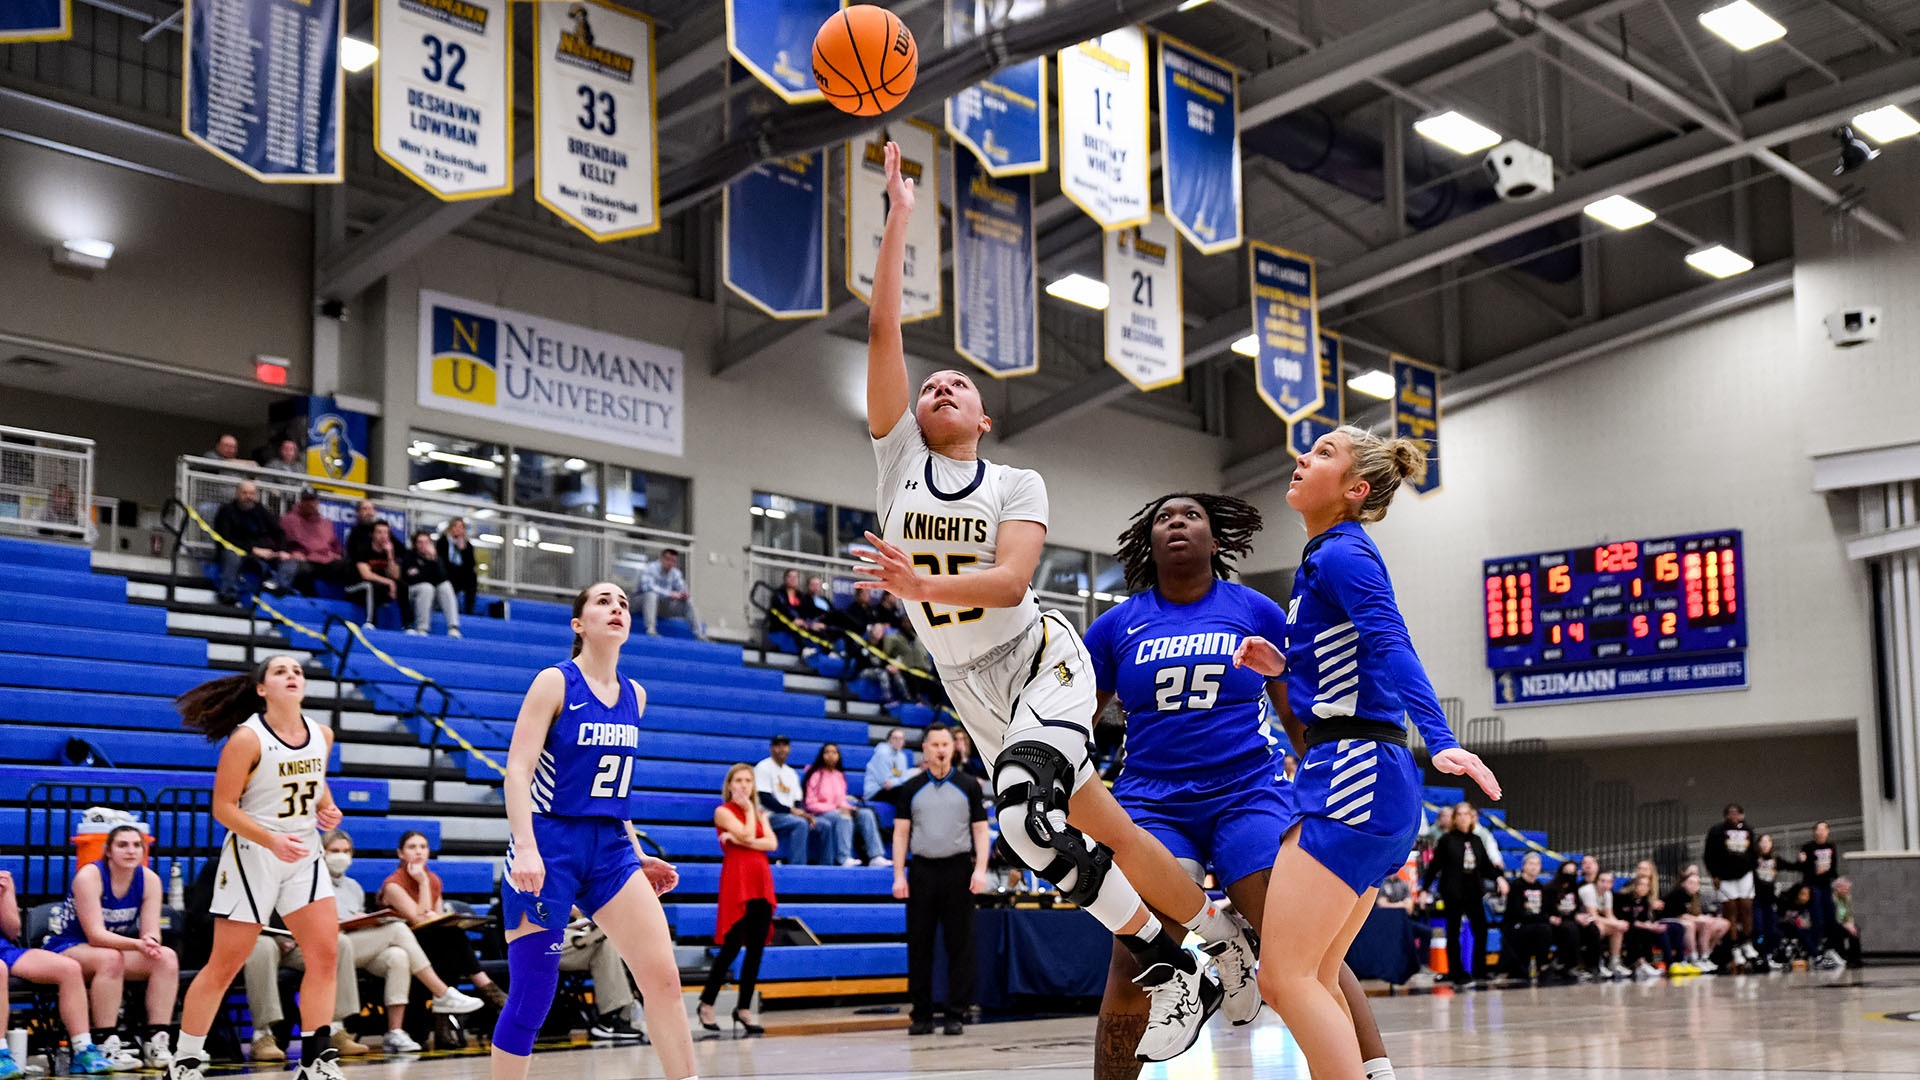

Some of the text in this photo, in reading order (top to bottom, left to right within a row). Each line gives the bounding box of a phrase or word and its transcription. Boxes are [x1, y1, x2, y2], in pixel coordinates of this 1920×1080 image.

[422, 33, 466, 92] 32
[407, 87, 481, 125] DESHAWN
[577, 84, 617, 136] 33
[409, 109, 477, 146] LOWMAN
[567, 137, 628, 168] BRENDAN
[579, 161, 616, 186] KELLY
[1131, 269, 1153, 309] 21
[453, 317, 480, 353] N
[504, 321, 675, 394] NEUMANN
[452, 359, 477, 393] U
[504, 363, 674, 430] UNIVERSITY
[903, 511, 988, 543] KNIGHTS
[1594, 541, 1639, 573] 1:22
[1632, 577, 1643, 598] 1
[1551, 624, 1562, 645] 1
[1632, 614, 1650, 639] 5
[1660, 612, 1678, 636] 2
[1134, 632, 1238, 665] CABRINI
[1154, 663, 1226, 712] 25
[1521, 660, 1742, 698] NEUMANN HOME OF THE KNIGHTS
[577, 722, 639, 749] CABRIN
[278, 758, 323, 777] KNIGHTS
[589, 753, 635, 799] 21
